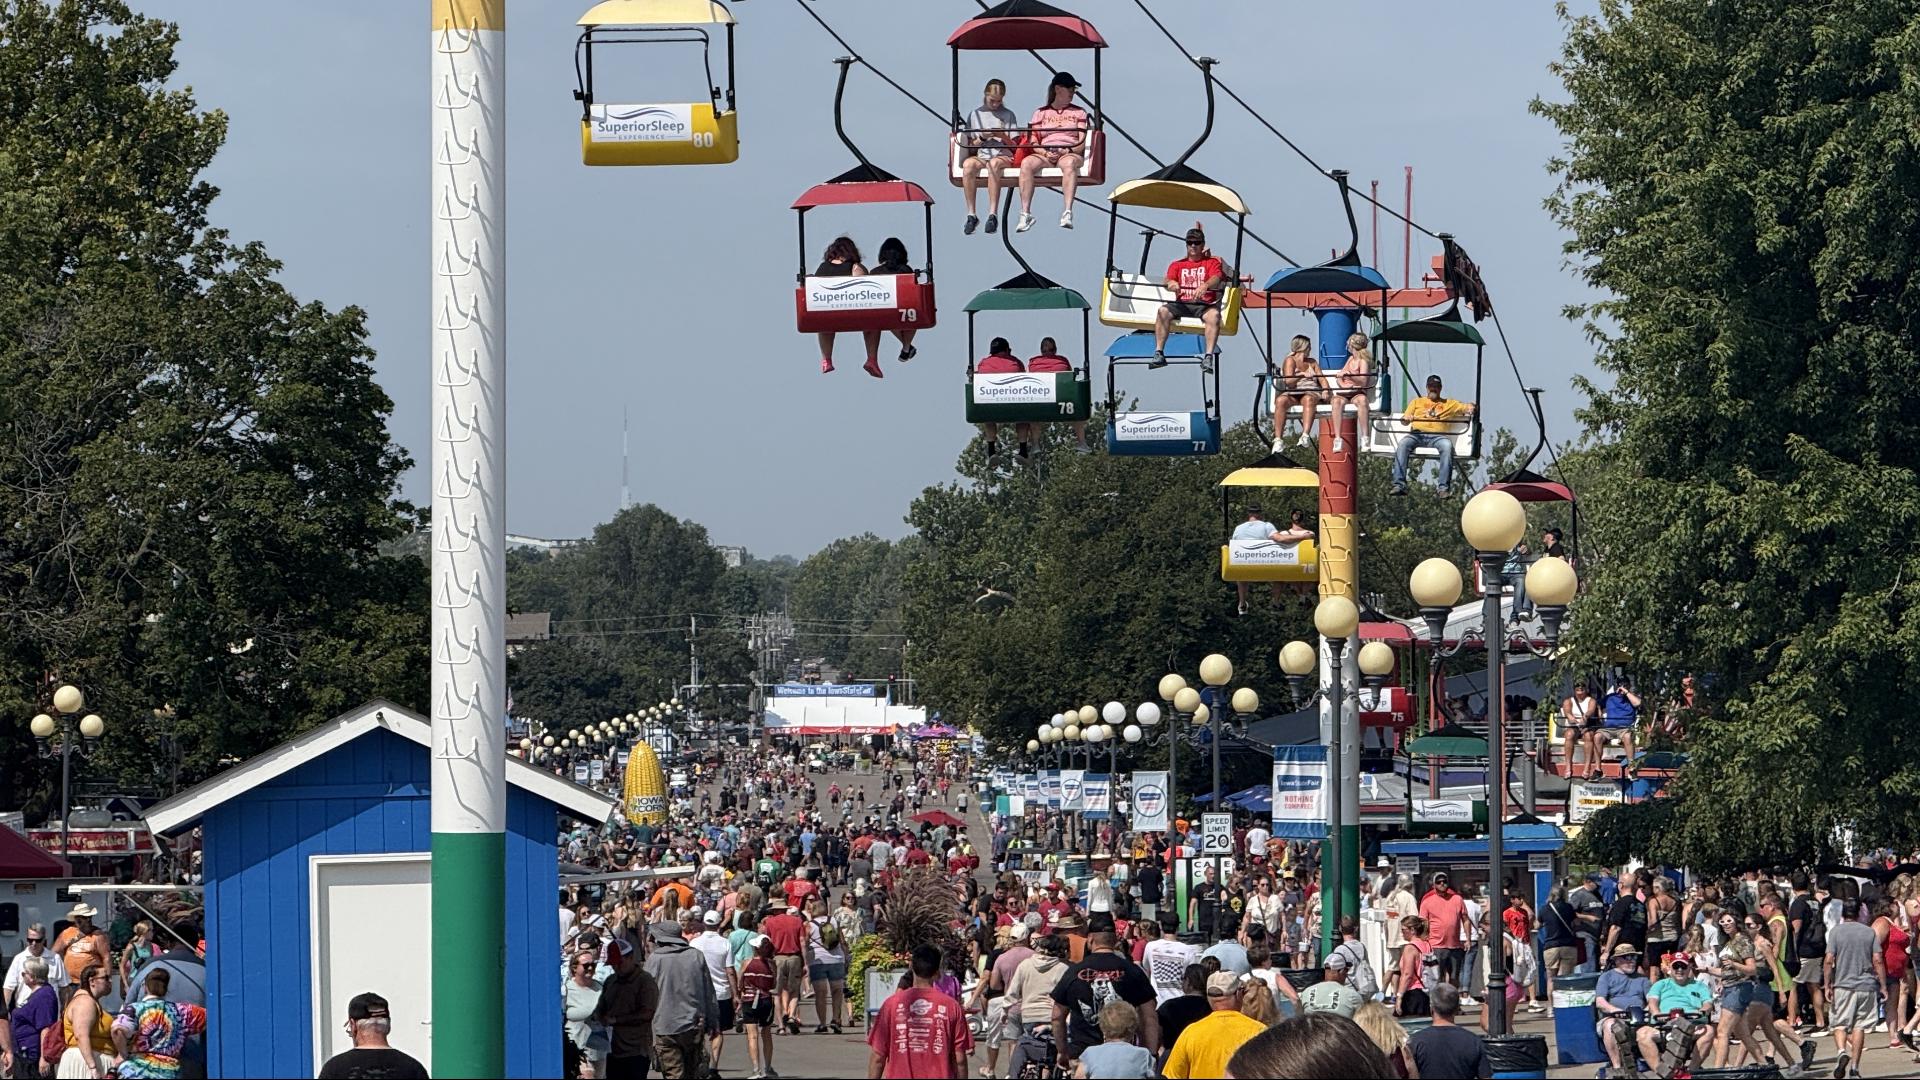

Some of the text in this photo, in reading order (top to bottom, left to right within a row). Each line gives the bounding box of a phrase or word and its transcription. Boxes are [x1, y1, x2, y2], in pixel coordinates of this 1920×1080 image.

[598, 120, 685, 134] SuperiorSleep
[693, 132, 713, 148] 80
[812, 290, 890, 303] SuperiorSleep
[899, 308, 917, 322] 79
[979, 386, 1050, 396] SuperiorSleep
[1058, 402, 1074, 414] 78
[1121, 424, 1186, 435] SuperiorSleep
[1192, 441, 1206, 451] 77
[1234, 550, 1294, 560] SuperiorSleep
[1391, 712, 1404, 722] 75
[638, 796, 664, 805] IOWA
[1472, 823, 1484, 832] 74
[1205, 834, 1229, 848] 20
